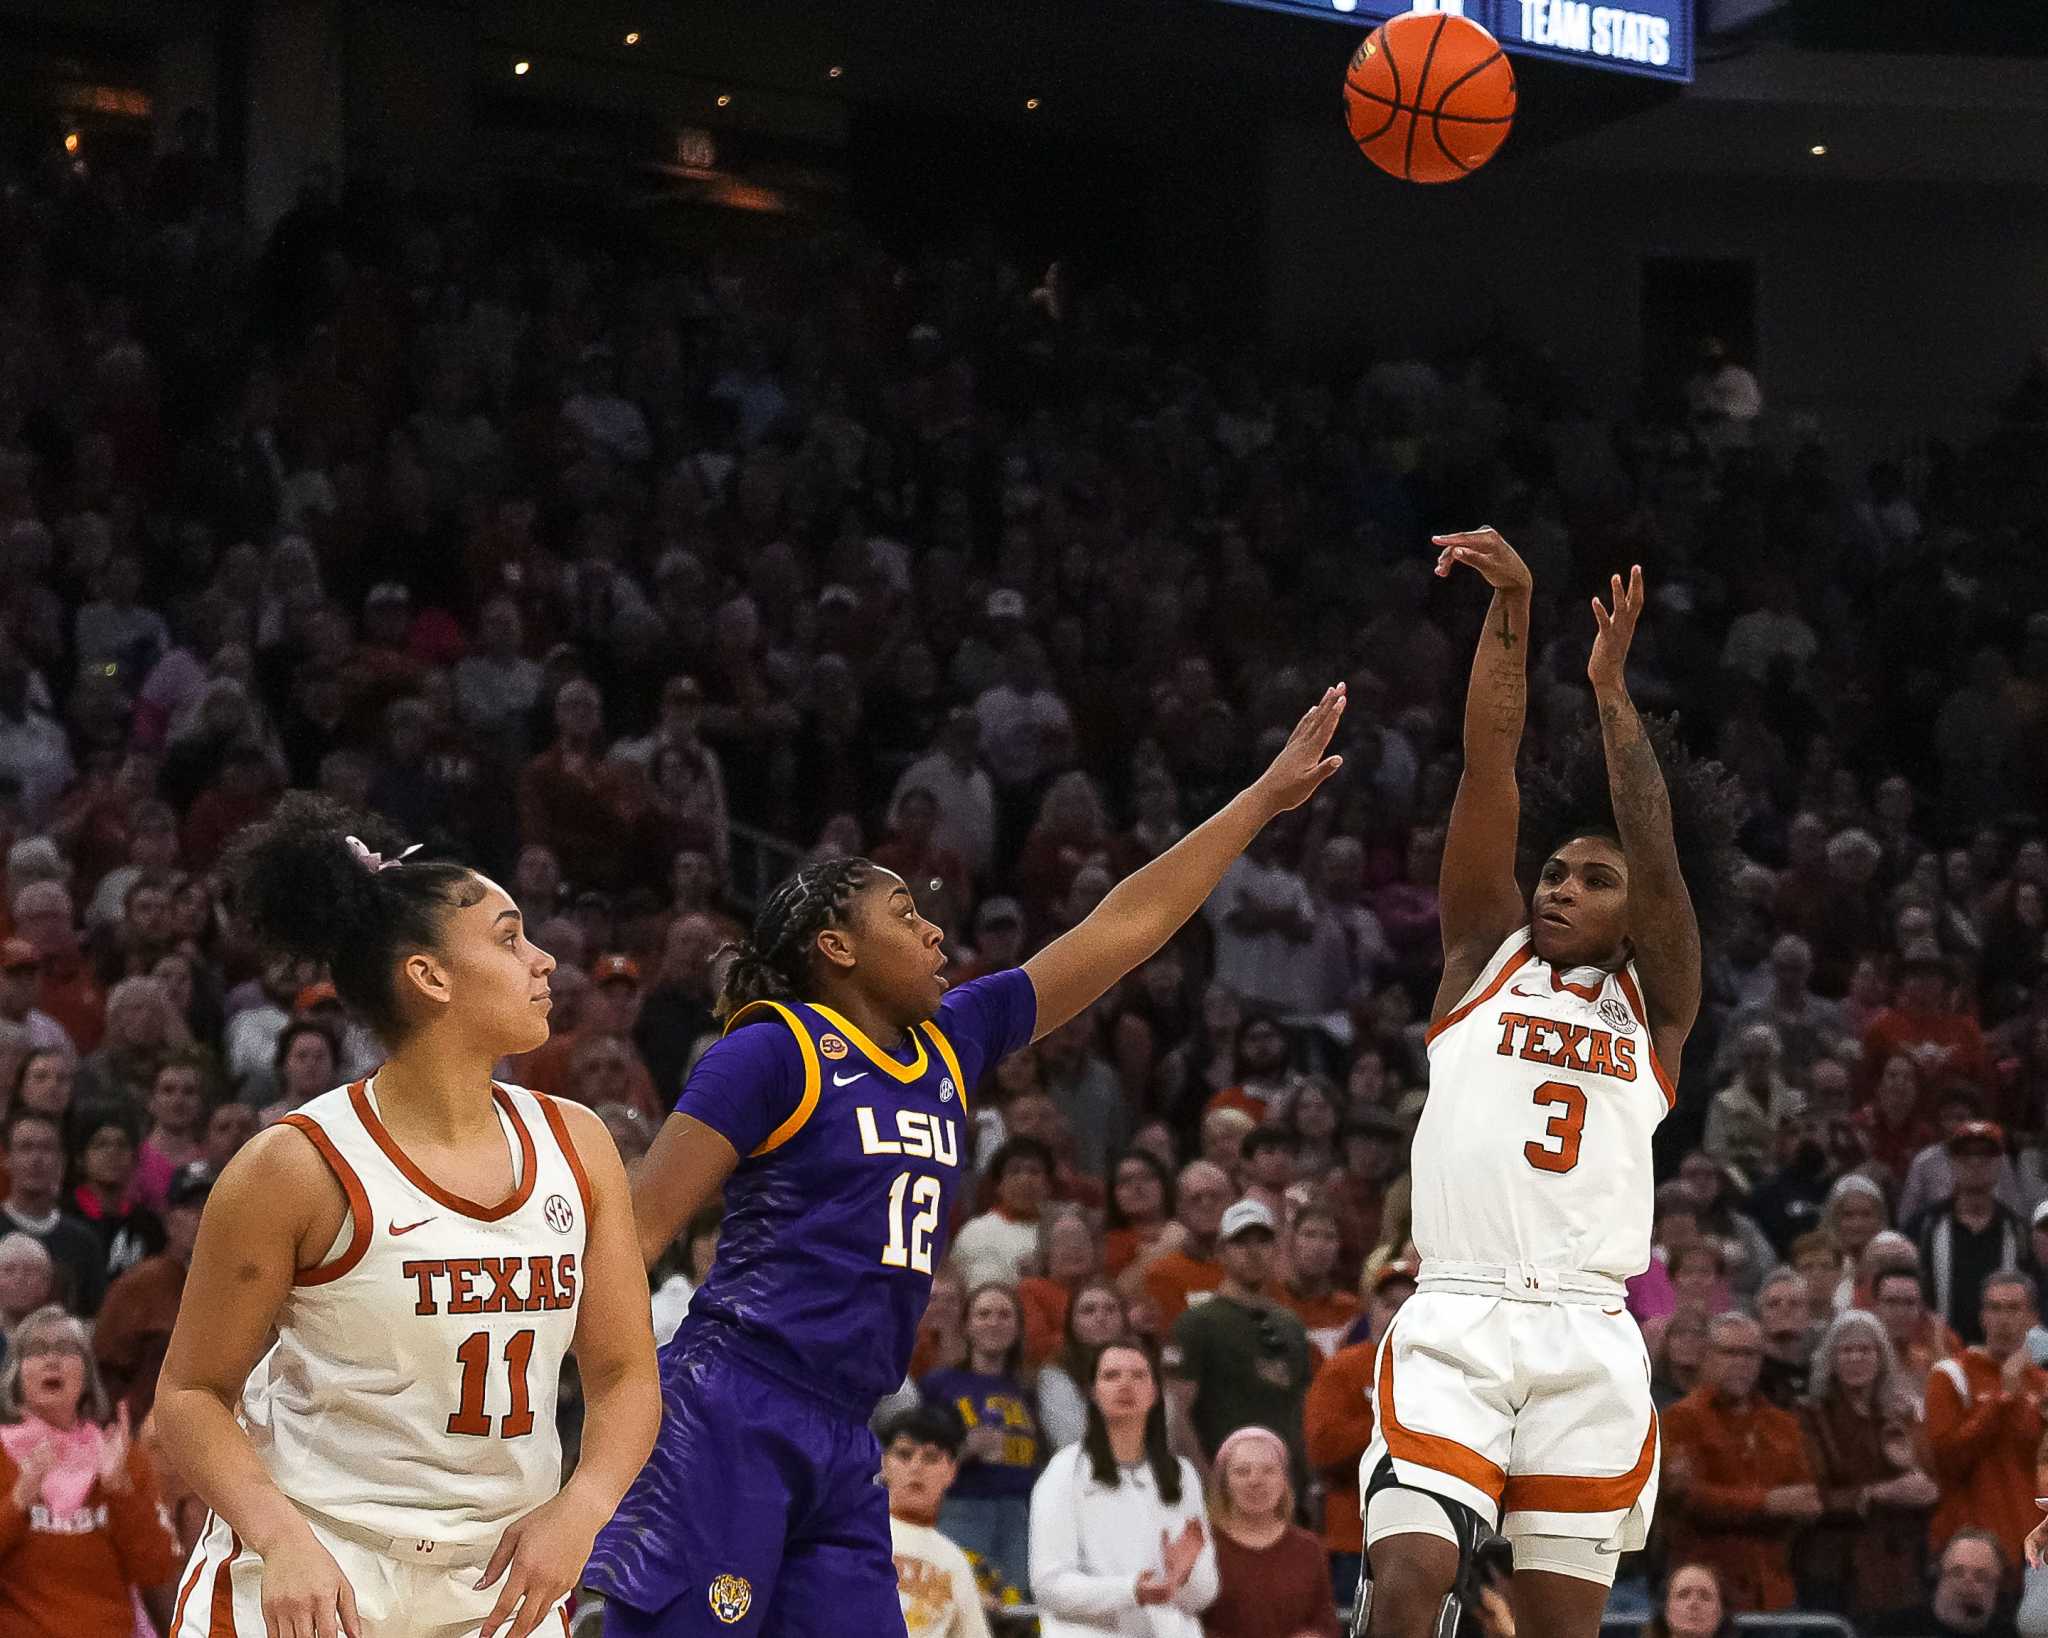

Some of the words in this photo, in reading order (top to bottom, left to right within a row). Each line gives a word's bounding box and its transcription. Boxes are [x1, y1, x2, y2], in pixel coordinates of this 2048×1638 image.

[1519, 0, 1591, 52] TEAM
[1592, 6, 1670, 66] STATS
[1497, 1012, 1637, 1082] TEXAS
[856, 1107, 958, 1167] LSU
[1523, 1080, 1588, 1174] 3
[881, 1172, 941, 1274] 12
[403, 1254, 576, 1316] TEXAS
[446, 1329, 535, 1439] 11
